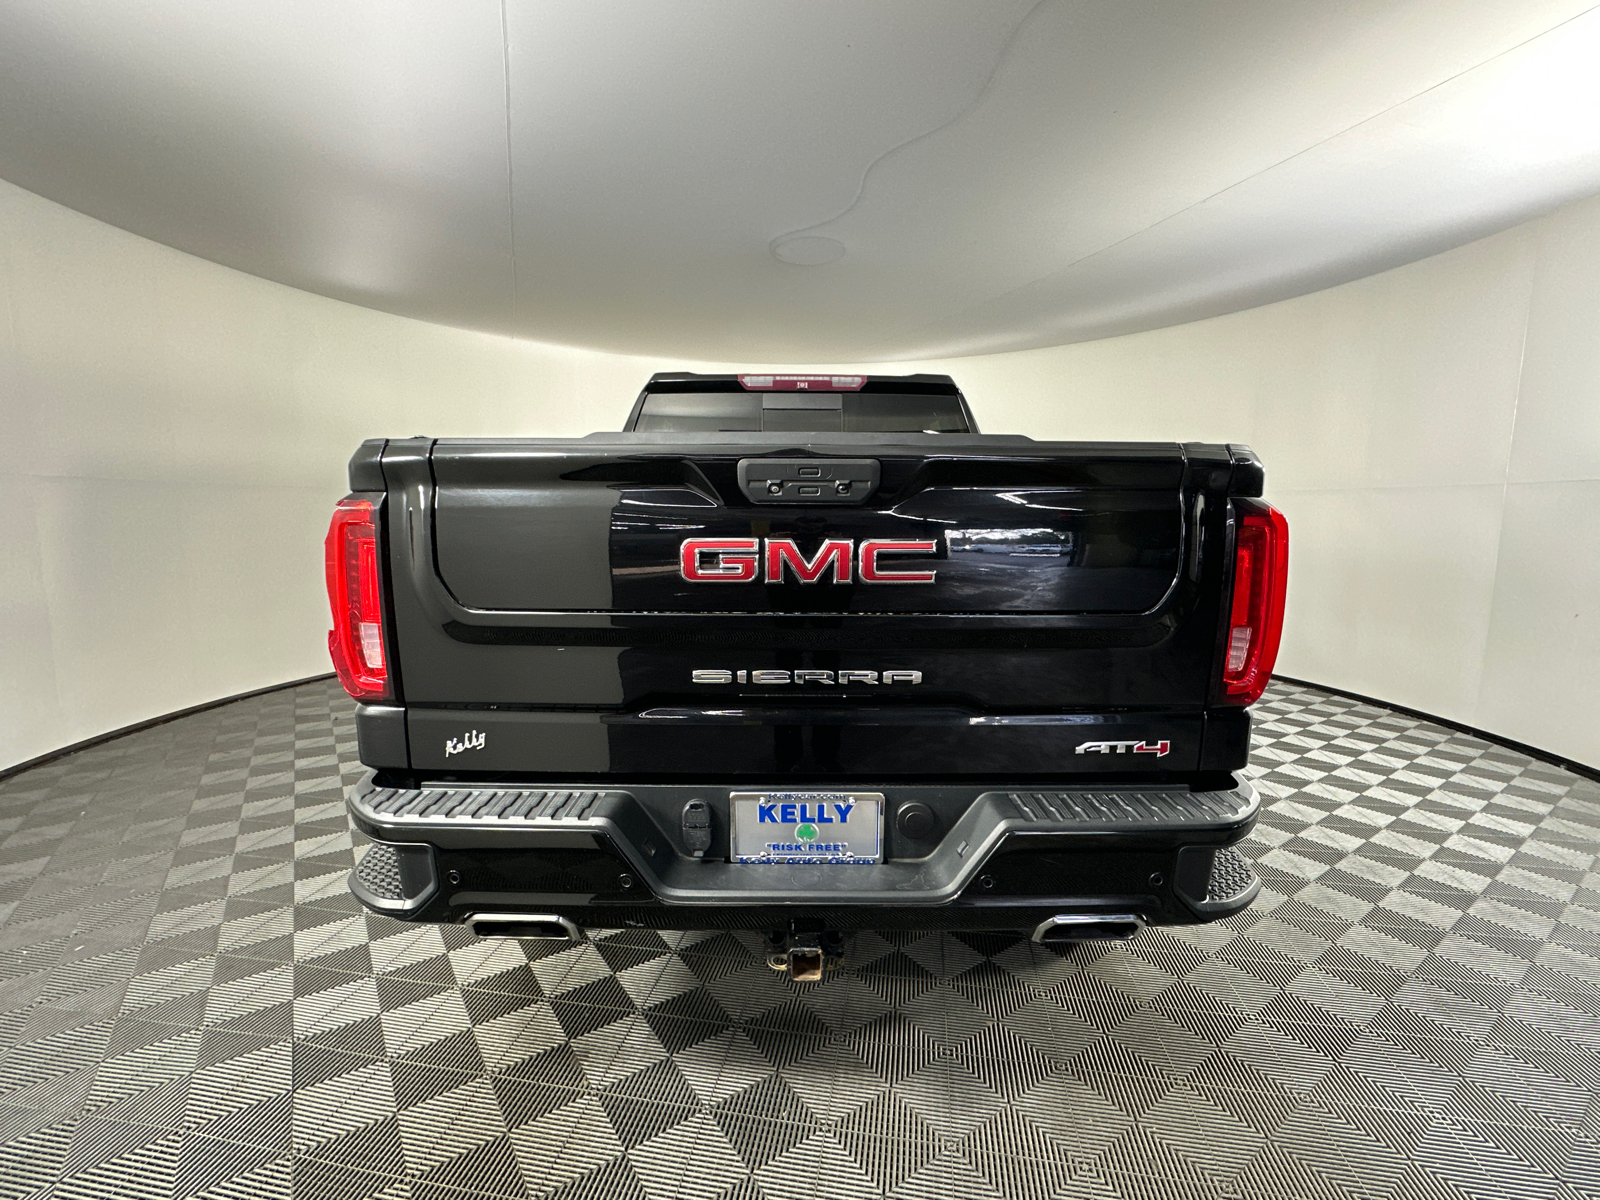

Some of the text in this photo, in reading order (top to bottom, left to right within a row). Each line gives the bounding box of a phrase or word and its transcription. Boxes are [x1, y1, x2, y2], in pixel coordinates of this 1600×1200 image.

[681, 537, 938, 585] GMC
[691, 669, 923, 685] SIERRA
[445, 729, 486, 758] Kelly
[1075, 740, 1171, 758] AT4
[758, 804, 854, 823] KELLY
[766, 843, 847, 852] "RISK FREE"
